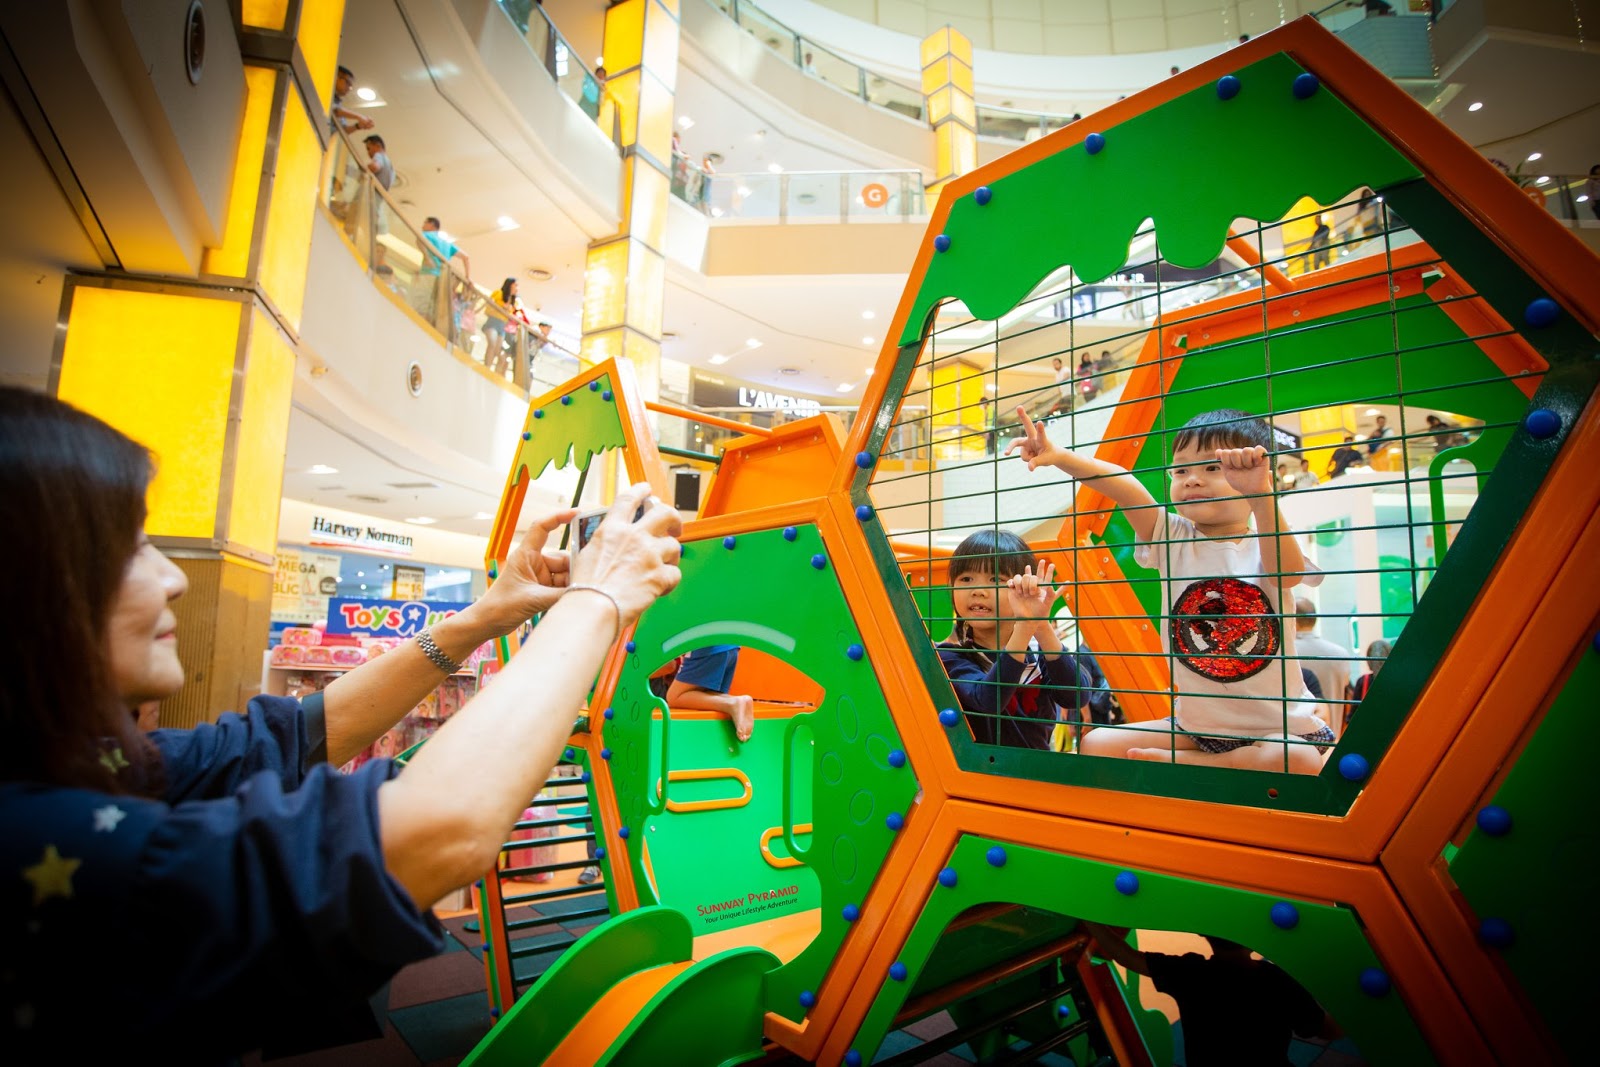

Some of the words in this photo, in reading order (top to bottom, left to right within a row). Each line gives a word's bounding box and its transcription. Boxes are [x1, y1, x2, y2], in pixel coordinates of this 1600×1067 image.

[868, 188, 881, 202] G
[313, 516, 362, 540] Harvey
[366, 526, 413, 547] Norman
[277, 560, 317, 574] MEGA
[272, 582, 299, 595] BLIC
[697, 897, 745, 917] SUNWAY
[747, 885, 799, 905] PYRAMID
[720, 911, 741, 920] Unique
[742, 904, 766, 916] Lifestyle
[767, 897, 798, 909] Adventure
